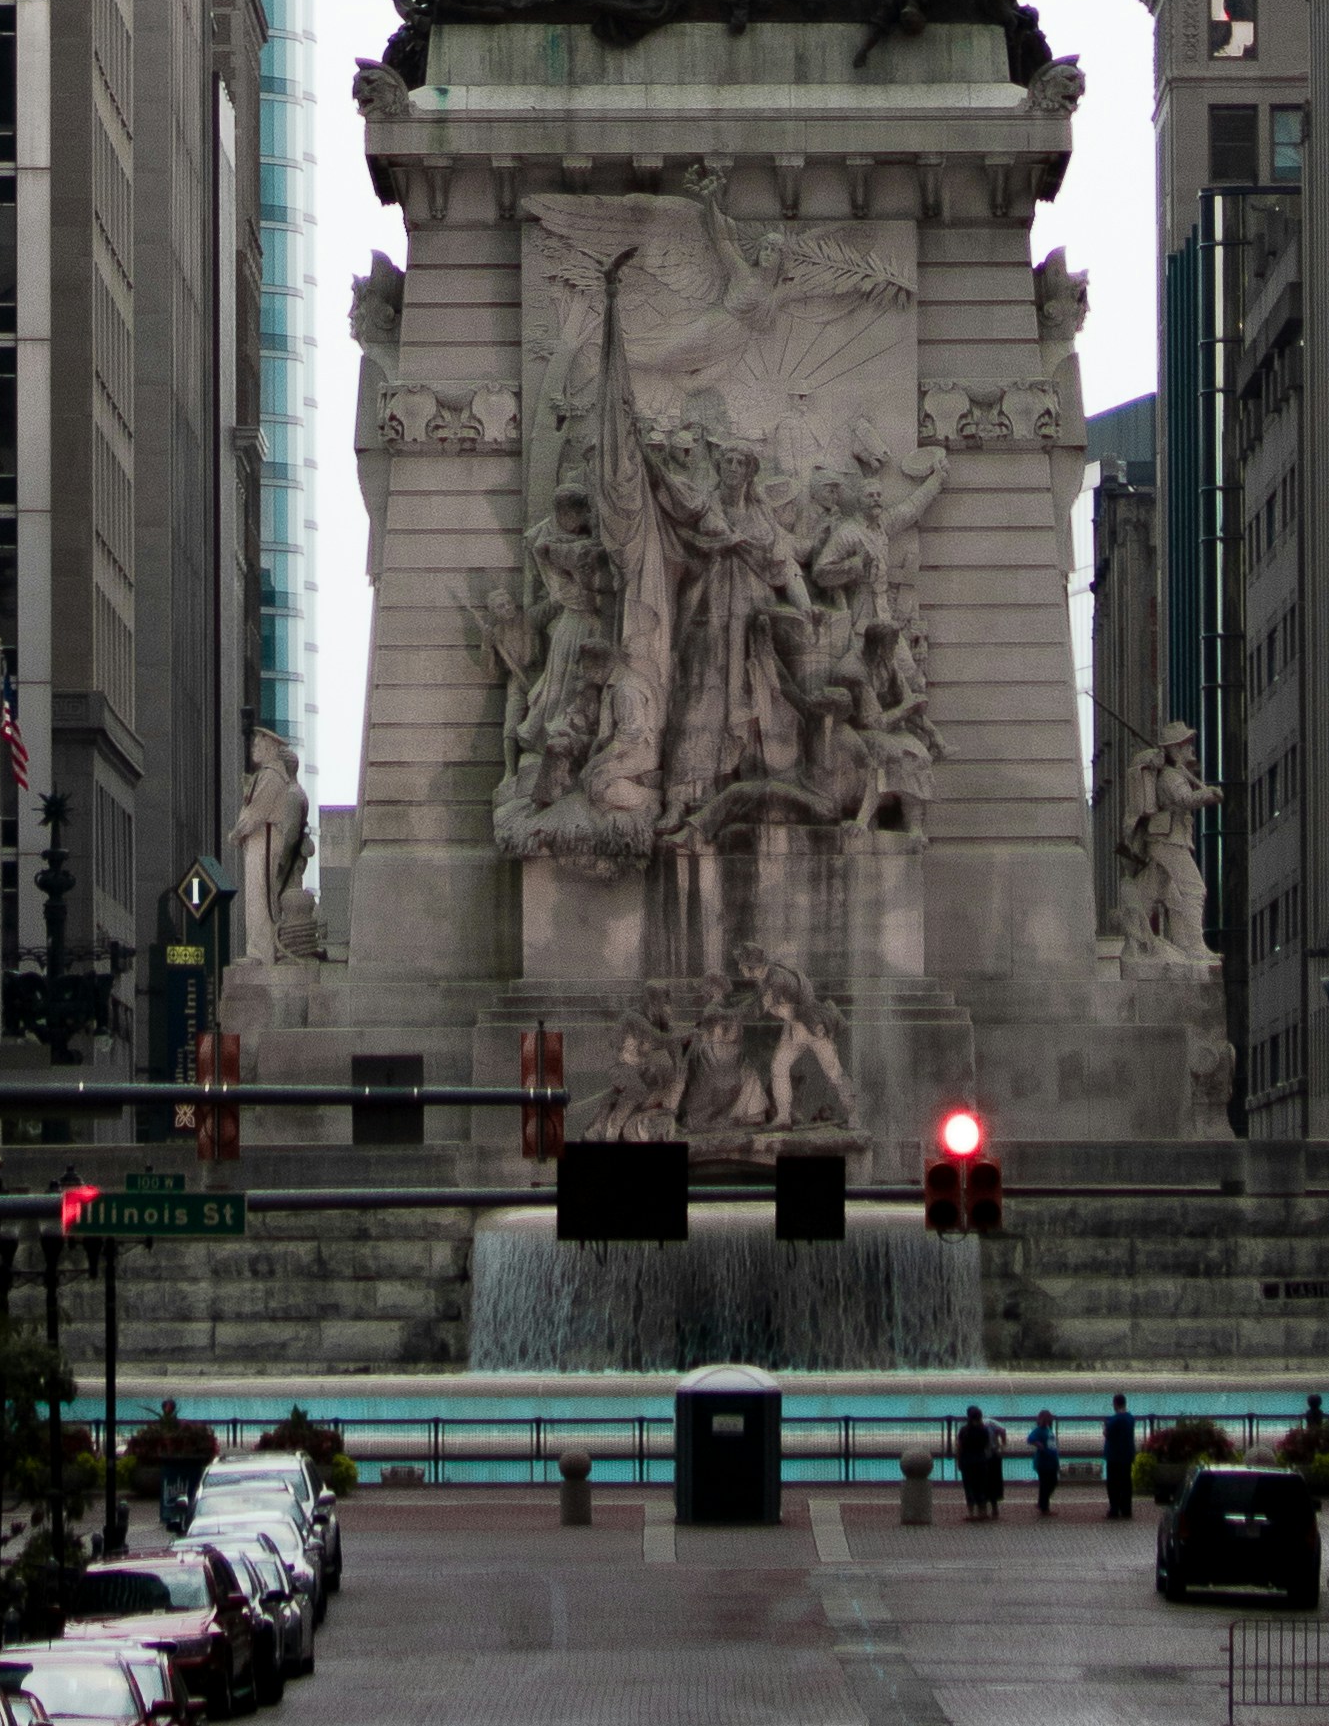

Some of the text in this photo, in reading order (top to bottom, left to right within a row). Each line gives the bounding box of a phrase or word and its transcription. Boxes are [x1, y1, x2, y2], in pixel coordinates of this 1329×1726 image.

[184, 977, 197, 1084] arden Inn
[136, 1175, 175, 1190] 100 W
[75, 1200, 235, 1227] Illinois St
